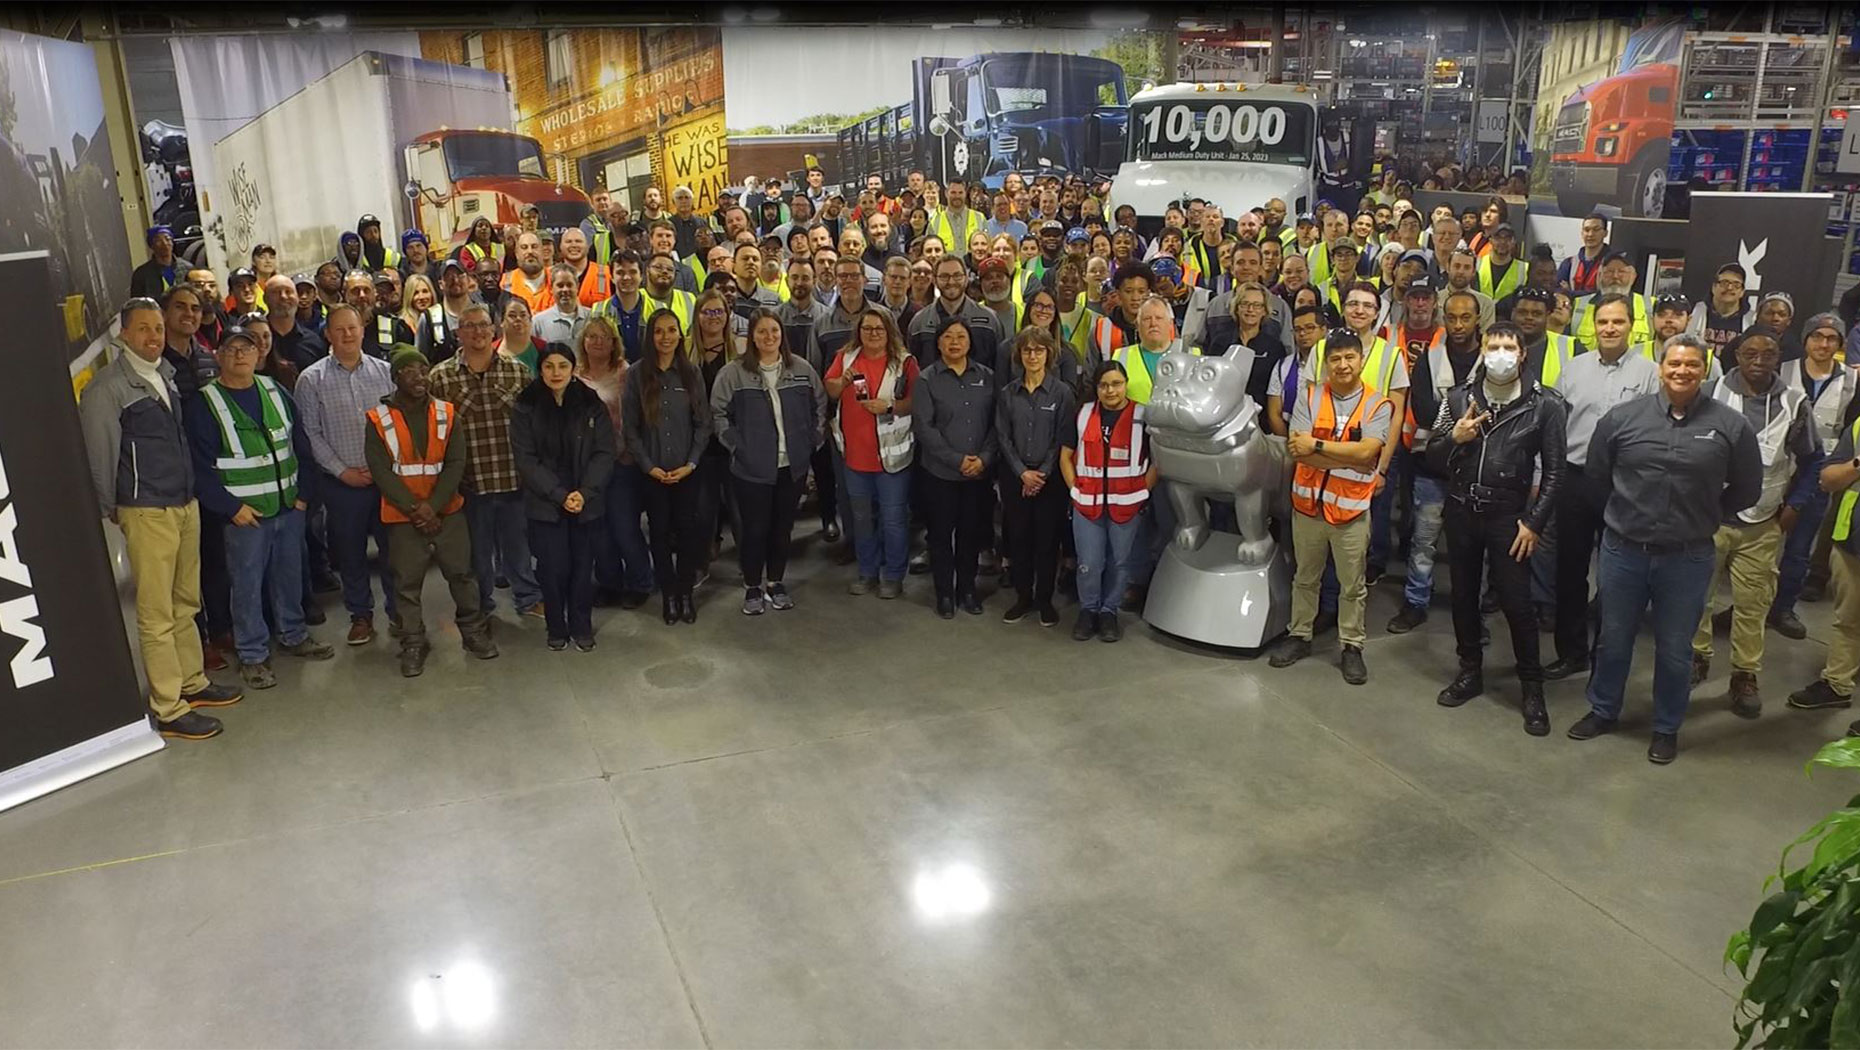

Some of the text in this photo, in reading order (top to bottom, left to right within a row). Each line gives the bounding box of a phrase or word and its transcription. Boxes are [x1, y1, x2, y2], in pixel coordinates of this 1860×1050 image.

[540, 88, 626, 134] WHOLESALE
[1144, 104, 1286, 151] 10,000
[1479, 116, 1505, 131] L100
[663, 122, 720, 149] HE WAS
[671, 134, 728, 178] WISE
[1194, 151, 1210, 160] Duty
[1211, 151, 1224, 159] Unit
[1252, 153, 1269, 161] 2023
[0, 450, 54, 689] MA
